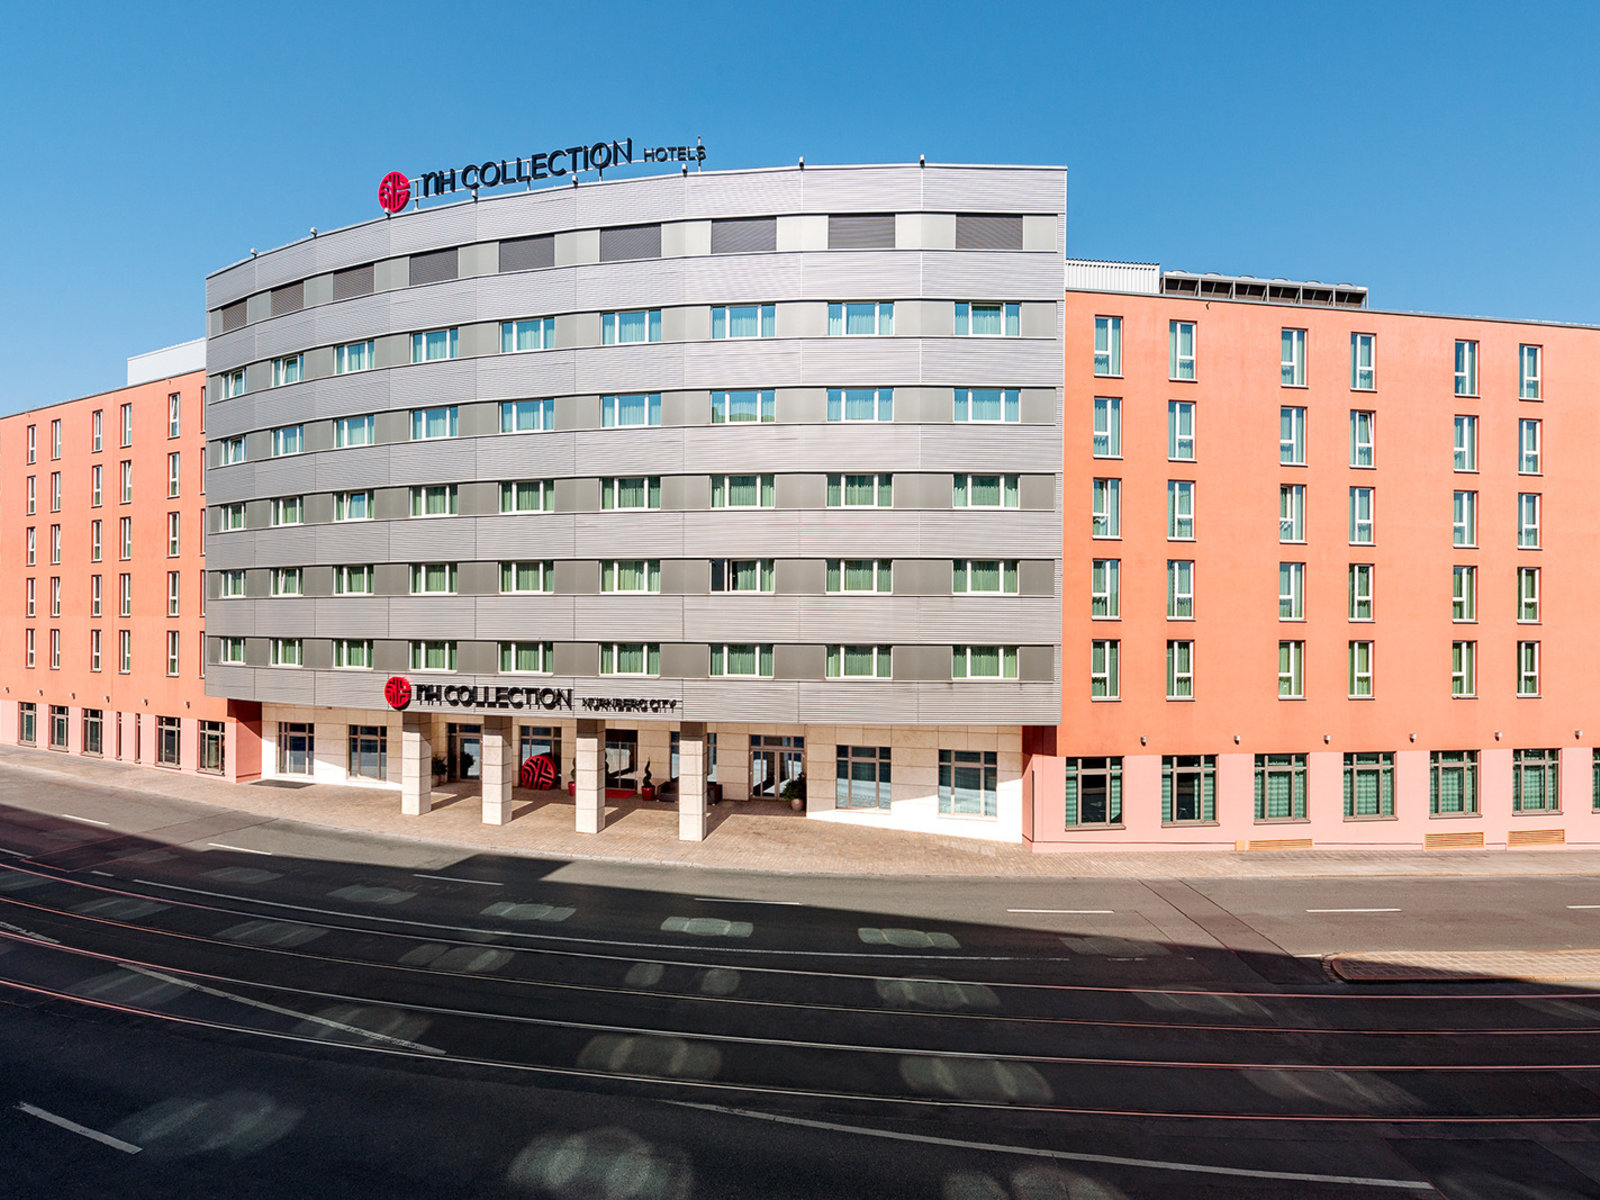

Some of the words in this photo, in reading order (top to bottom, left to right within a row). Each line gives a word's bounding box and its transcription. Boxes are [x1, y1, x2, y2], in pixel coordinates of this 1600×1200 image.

[461, 138, 632, 189] COLLECTION
[644, 145, 706, 162] HOTELS
[445, 685, 573, 709] COLLECTION
[650, 699, 677, 712] CITY
